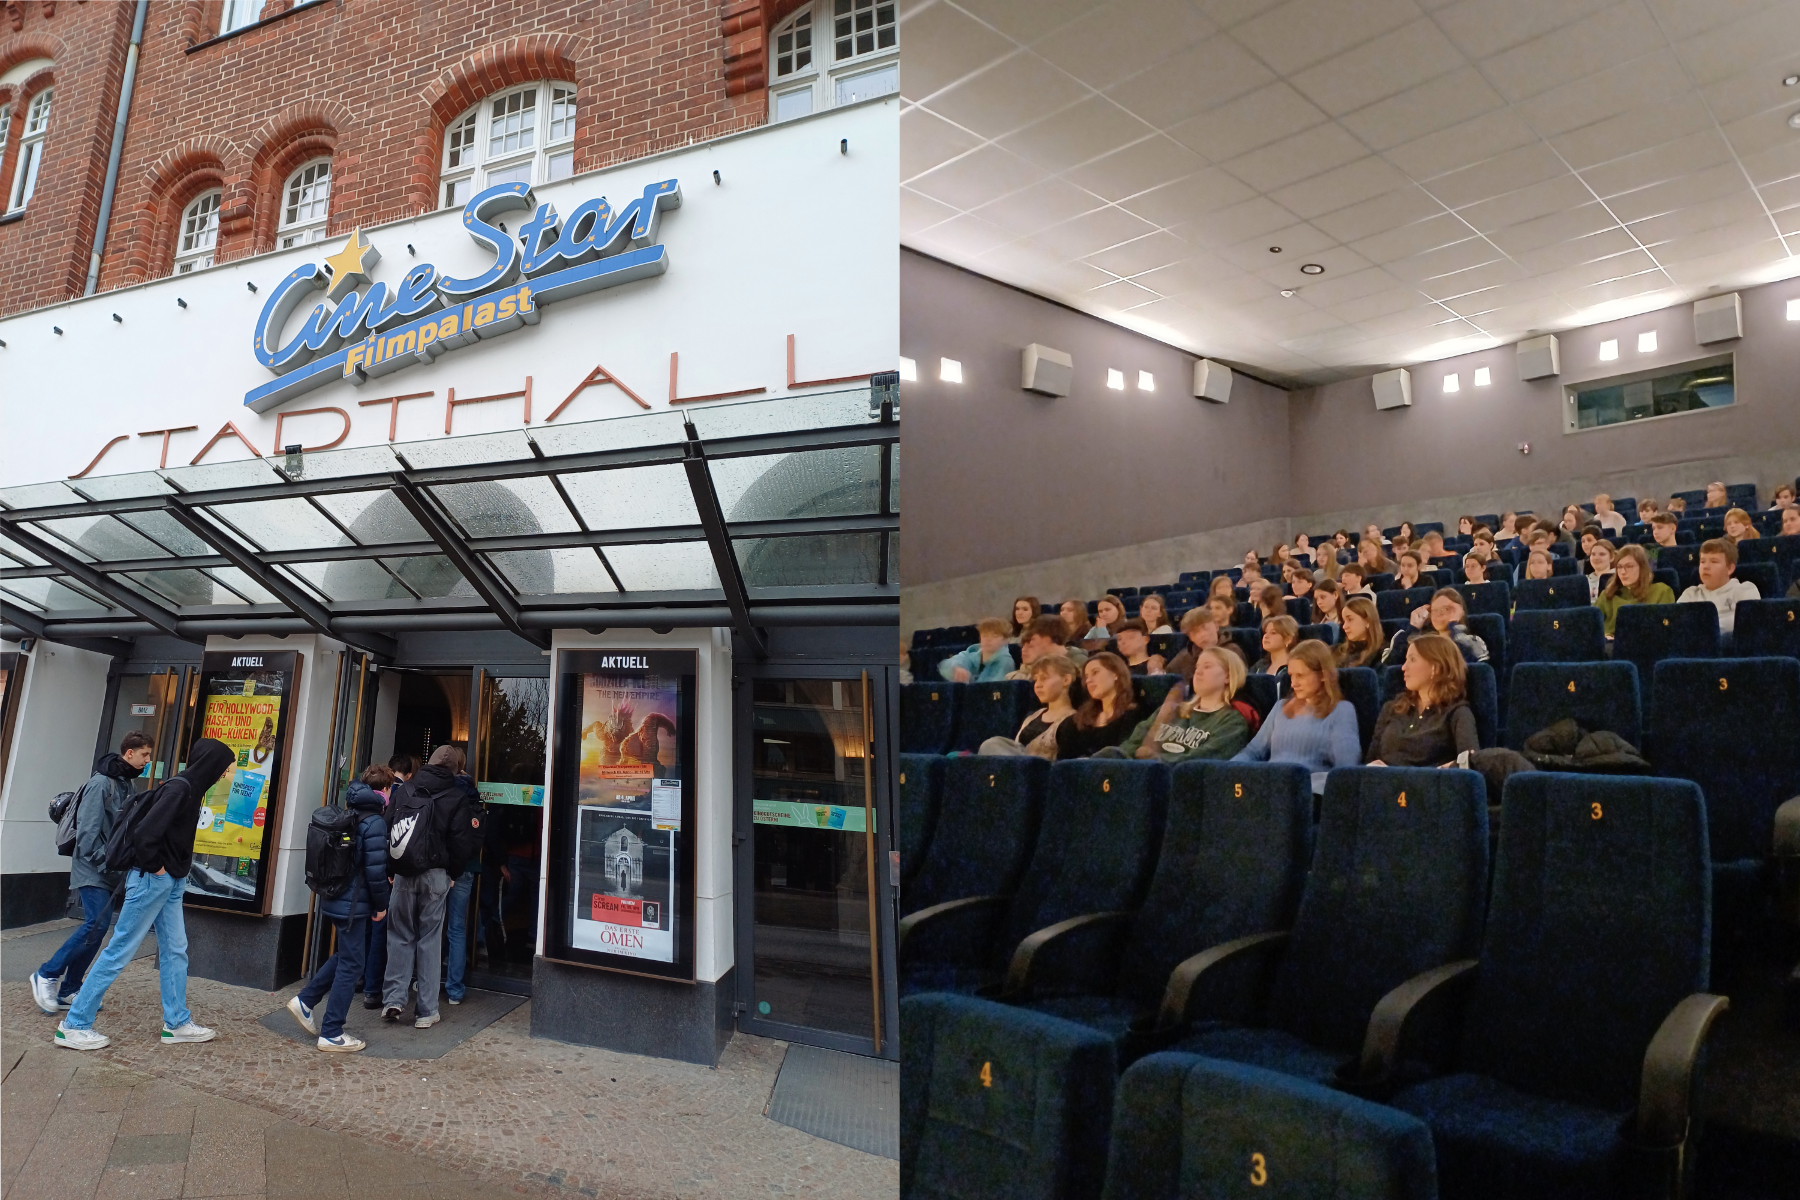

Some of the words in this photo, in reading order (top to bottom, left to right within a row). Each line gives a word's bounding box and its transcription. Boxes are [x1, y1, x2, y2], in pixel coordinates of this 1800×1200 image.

[254, 179, 682, 373] CineStar
[343, 286, 534, 376] Filmpalast
[67, 333, 896, 479] STADTHALL
[1549, 587, 1555, 596] 6
[1787, 610, 1795, 622] 3
[1553, 620, 1559, 630] 5
[231, 656, 264, 667] AKTUELL
[601, 656, 649, 669] AKTUELL
[1567, 680, 1576, 693] 4
[1718, 677, 1728, 691] 3
[596, 689, 611, 699] THE
[630, 691, 660, 701] EMPIRE
[208, 700, 225, 714] FÜR
[225, 702, 279, 715] HOLLYWOOD-
[205, 714, 232, 727] HASEN
[235, 715, 252, 727] UND
[203, 726, 258, 740] KINO-KÜKEN!
[1103, 779, 1110, 793] 6
[1234, 783, 1242, 798] 5
[1397, 791, 1407, 807] 4
[1591, 802, 1603, 820] 3
[391, 816, 414, 846] NIKE
[593, 900, 619, 912] SCREAM
[604, 924, 618, 932] DAS
[619, 926, 640, 936] ERSTE
[600, 930, 644, 950] OMEN
[979, 1061, 993, 1088] 4
[1250, 1152, 1267, 1187] 3
